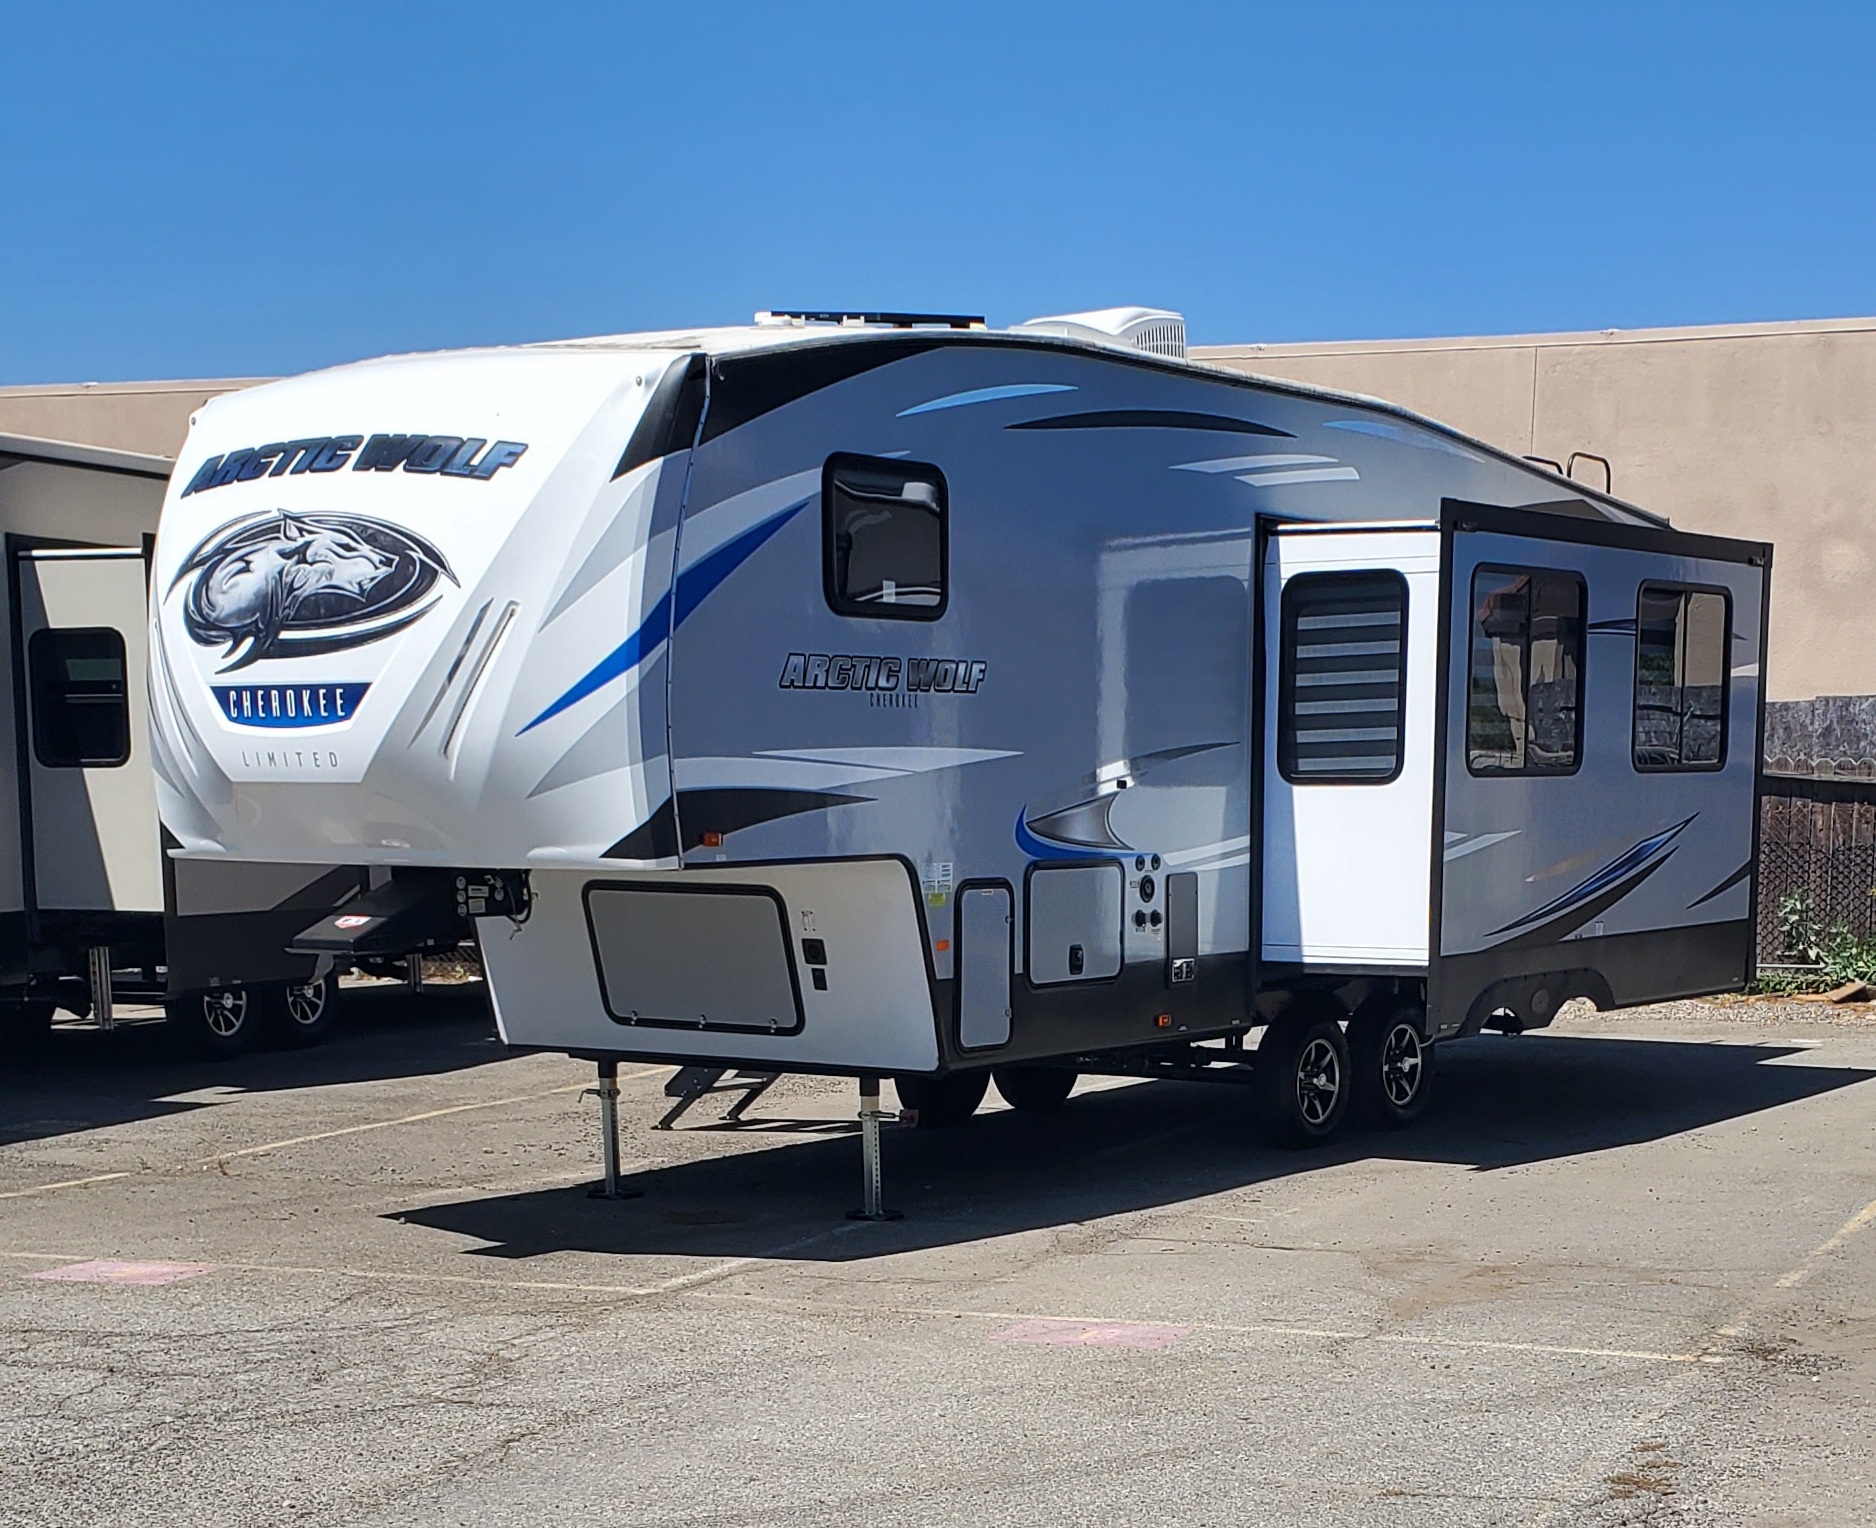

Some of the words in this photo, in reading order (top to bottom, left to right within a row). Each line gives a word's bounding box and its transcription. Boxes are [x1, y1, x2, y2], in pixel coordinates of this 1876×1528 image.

[181, 434, 364, 499] ARCTIC
[352, 434, 529, 481] WOLF
[779, 653, 902, 691] ARCTIC
[907, 658, 987, 694] WOLF
[229, 688, 346, 718] CHEROKEE
[869, 692, 919, 709] CHEROKEE
[242, 751, 338, 768] LIMITED
